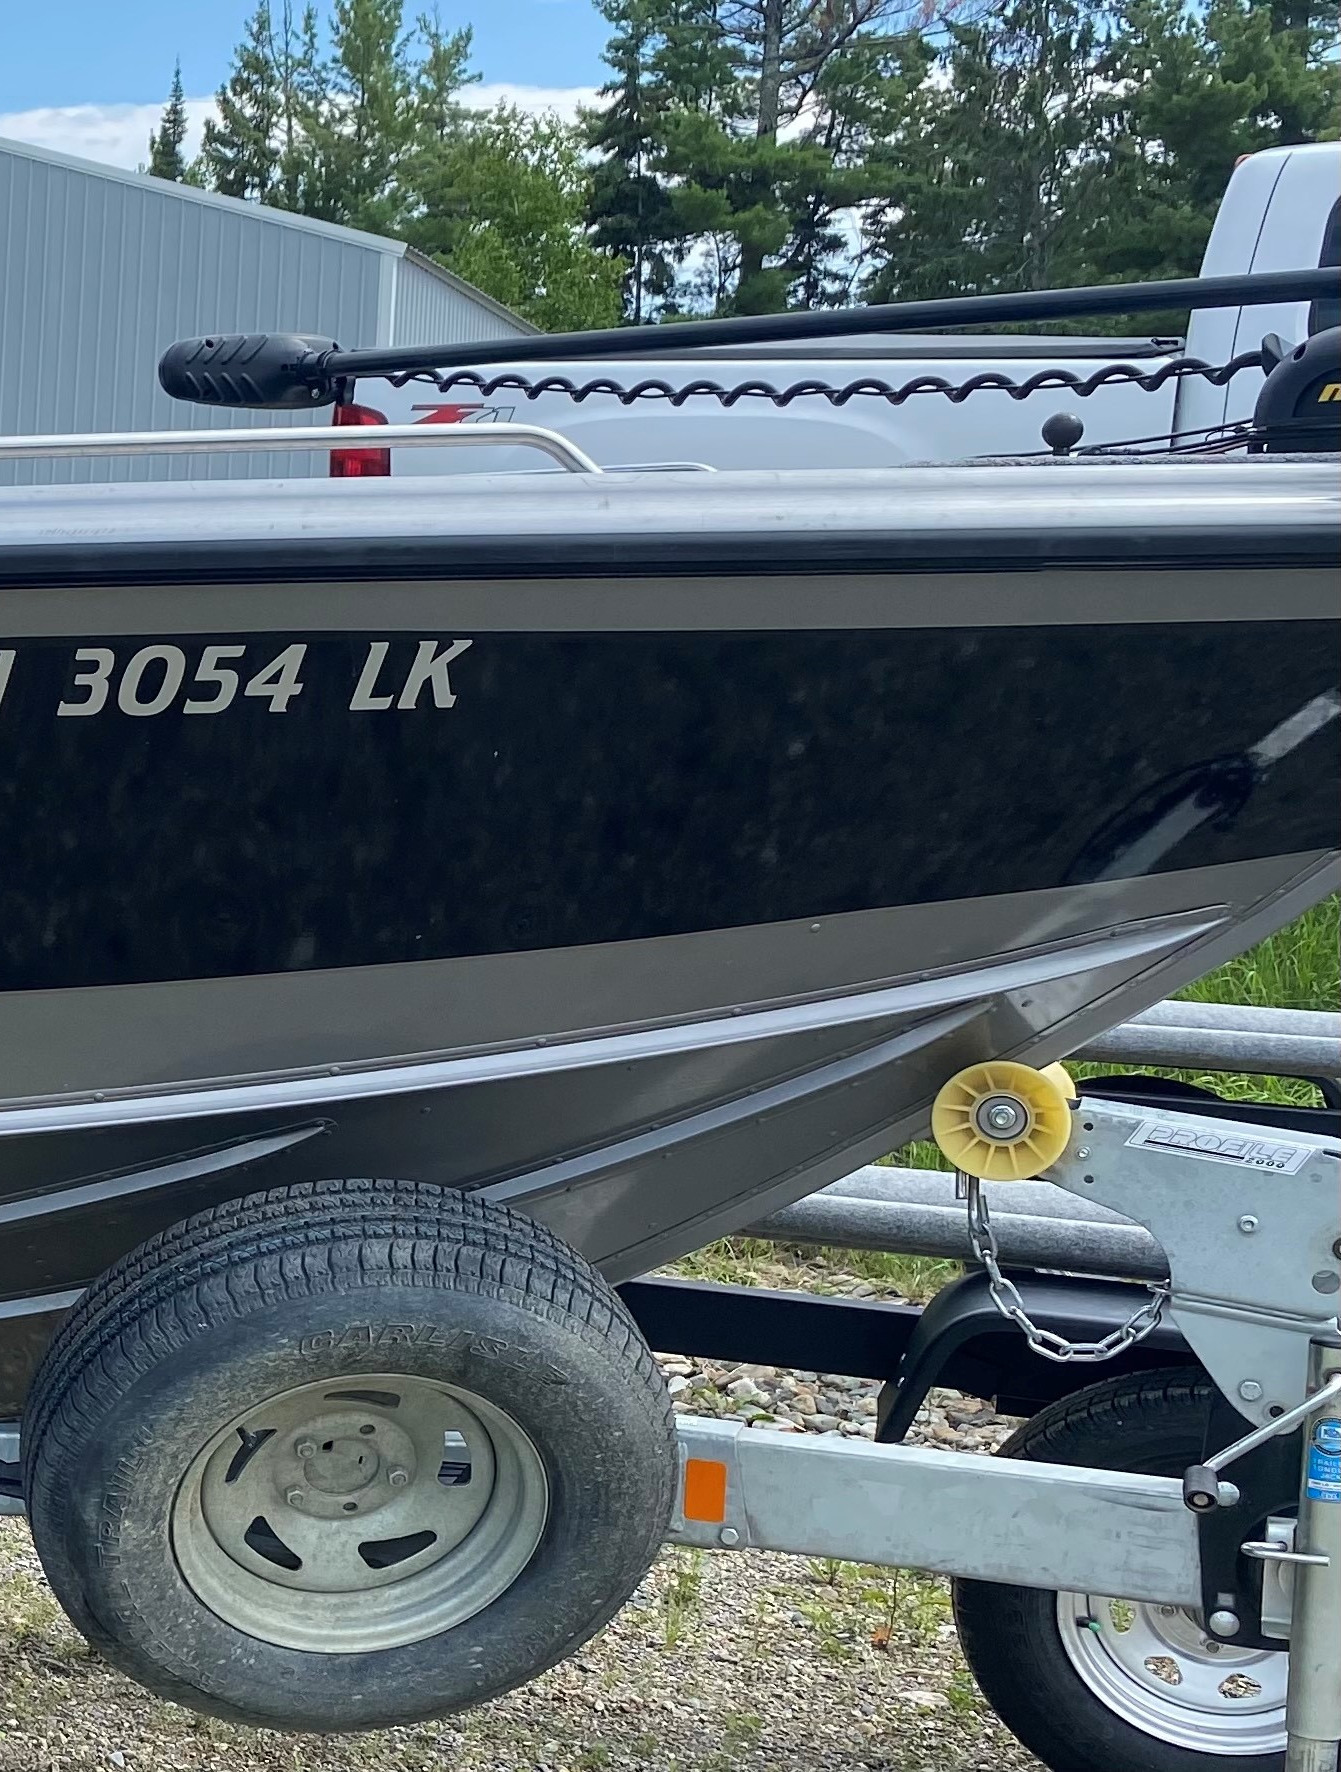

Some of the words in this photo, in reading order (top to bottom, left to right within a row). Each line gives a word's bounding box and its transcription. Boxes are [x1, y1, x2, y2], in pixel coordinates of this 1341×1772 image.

[57, 644, 308, 717] 3054
[349, 639, 473, 711] LK
[1147, 1125, 1298, 1163] PROFILE
